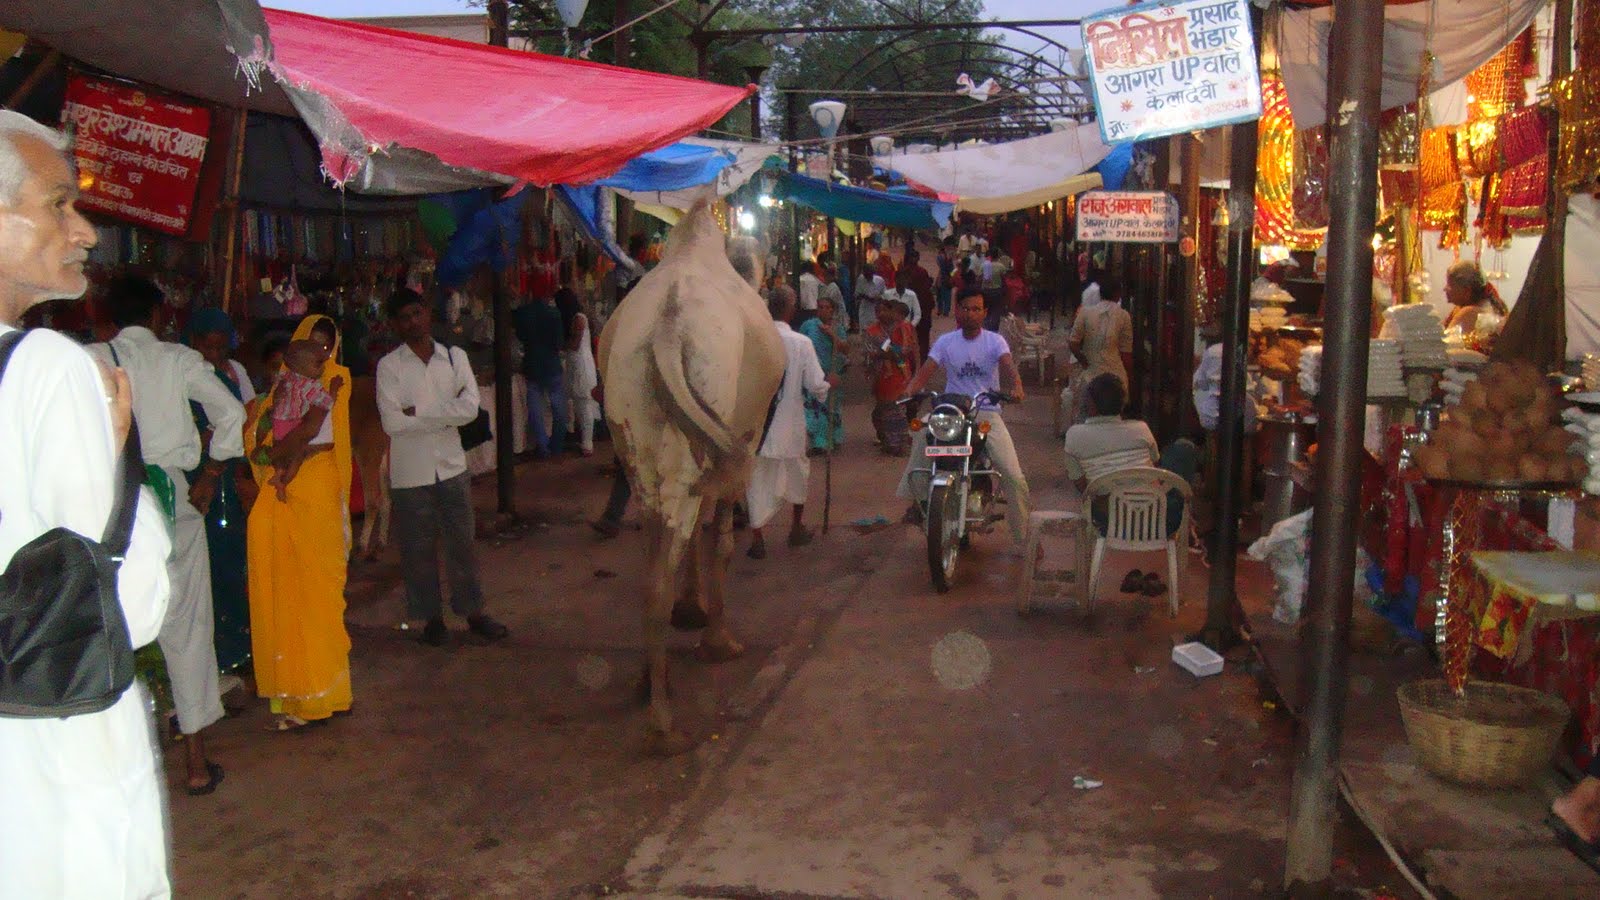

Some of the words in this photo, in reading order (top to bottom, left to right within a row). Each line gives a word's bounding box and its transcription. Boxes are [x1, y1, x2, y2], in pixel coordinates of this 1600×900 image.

[1187, 1, 1241, 29] प्रसाद
[1188, 25, 1242, 49] भंडार
[1105, 66, 1165, 95] आगरा
[1171, 56, 1200, 82] UP
[1204, 48, 1241, 74] वाले
